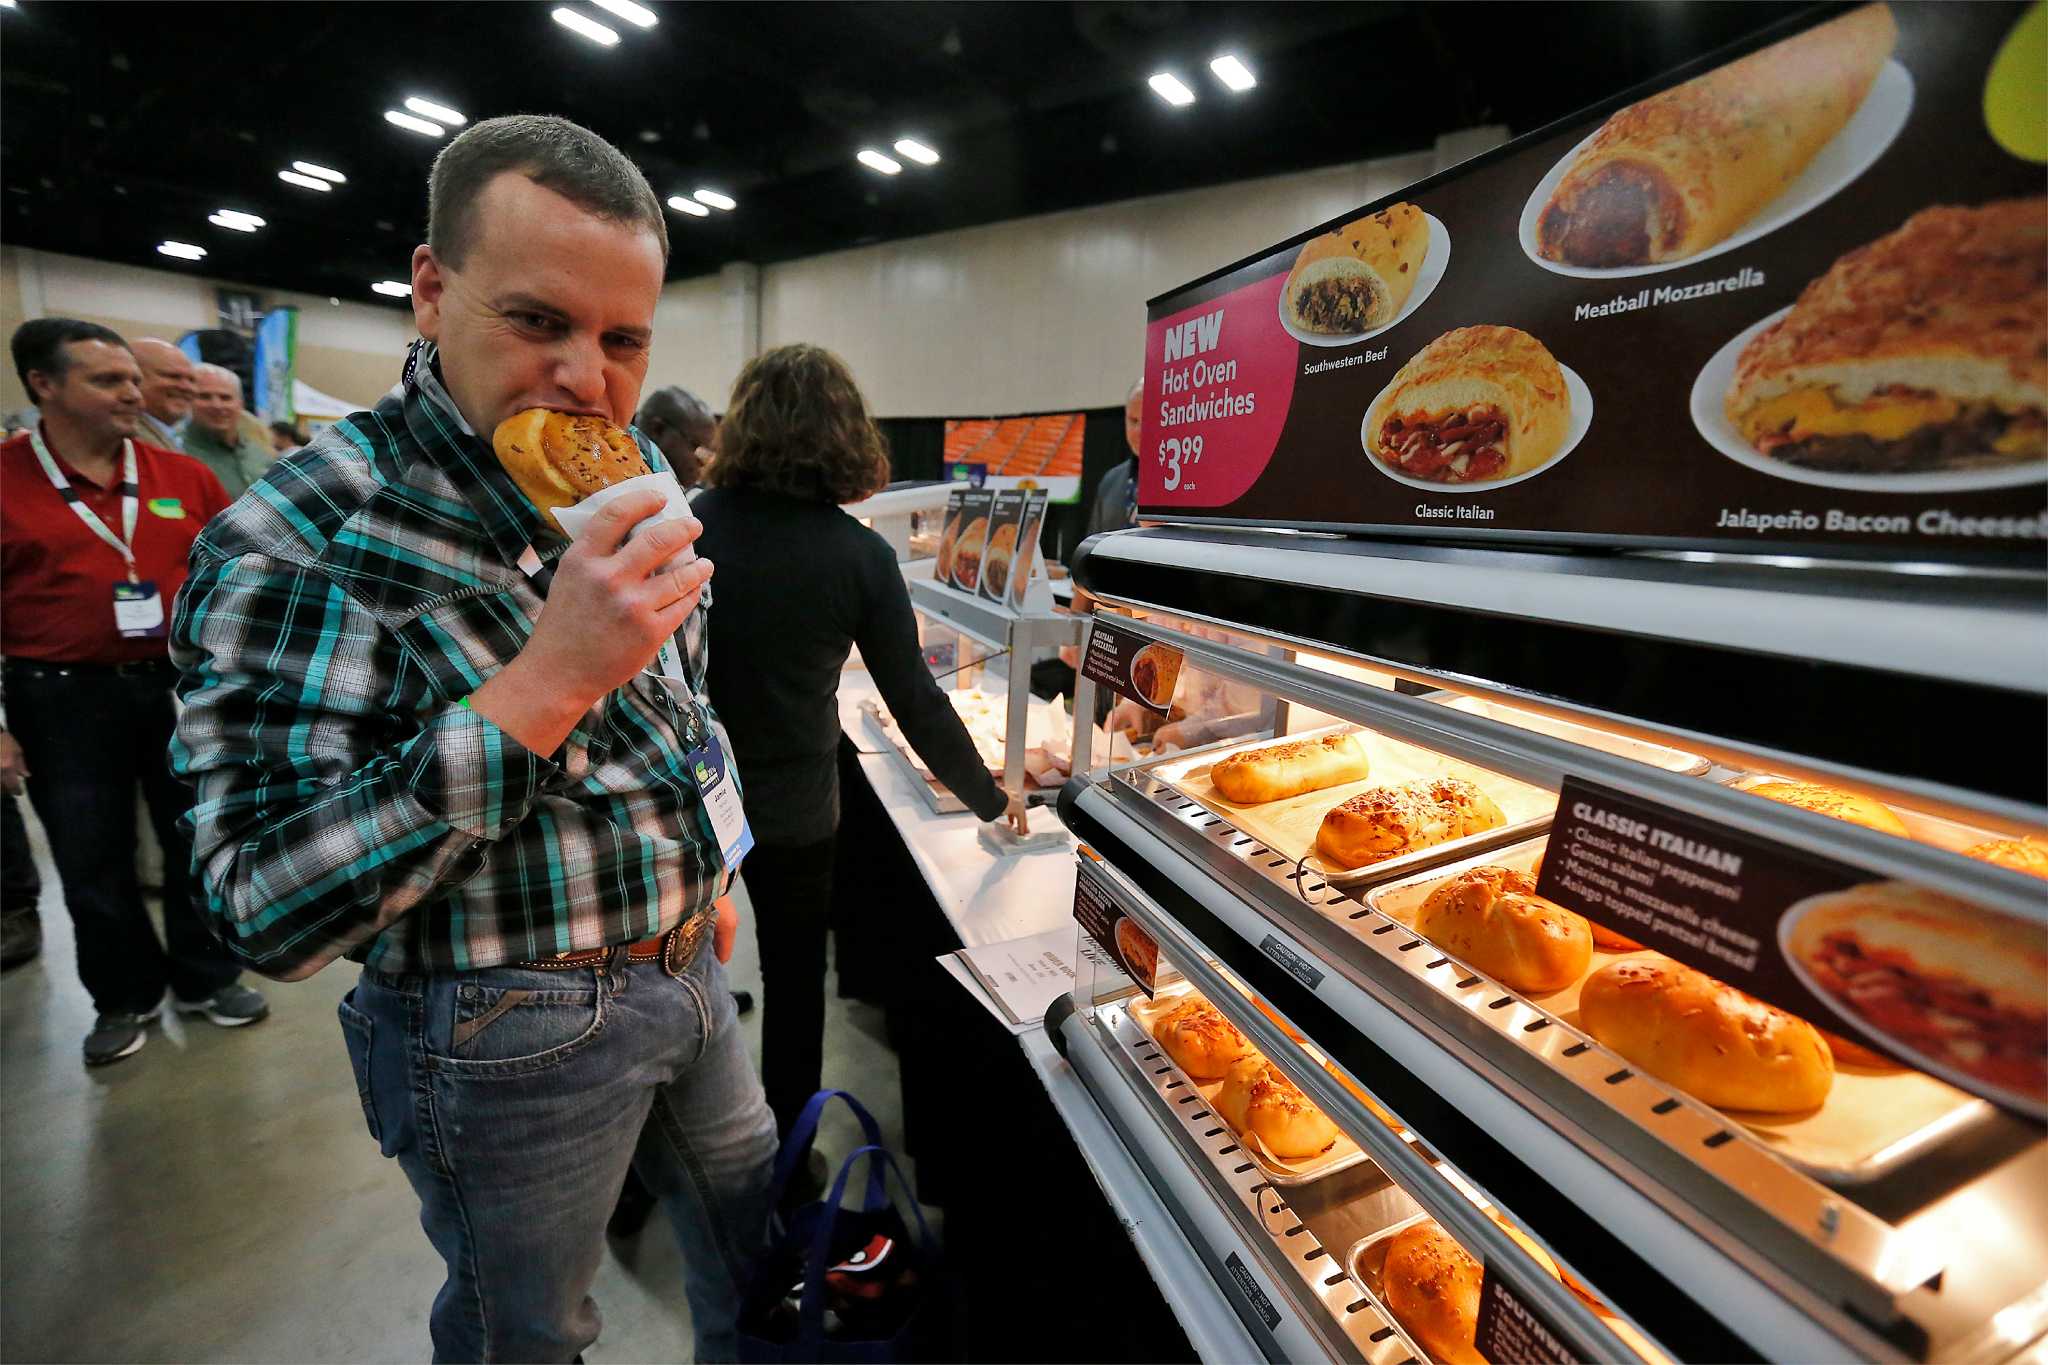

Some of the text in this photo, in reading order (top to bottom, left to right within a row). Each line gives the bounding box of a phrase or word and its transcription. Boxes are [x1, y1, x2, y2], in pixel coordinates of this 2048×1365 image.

[1574, 268, 1765, 321] Meatball Mozzarella
[1163, 309, 1224, 363] NEW
[1304, 347, 1388, 375] Southwestern Beef
[1162, 359, 1237, 395] Hot Oven
[1160, 388, 1255, 427] Sandwiches
[1184, 481, 1196, 491] each
[1415, 503, 1494, 520] Classic Italian
[1717, 508, 1820, 533] Jalapeño
[1825, 510, 1911, 533] Bacon
[1573, 802, 1743, 876] CLASSIC ITALIAN
[1574, 827, 1617, 854] Classic
[1570, 843, 1609, 869] Genoa
[1275, 943, 1311, 972] CAUTION HOT
[1239, 1266, 1258, 1291] CAUTION
